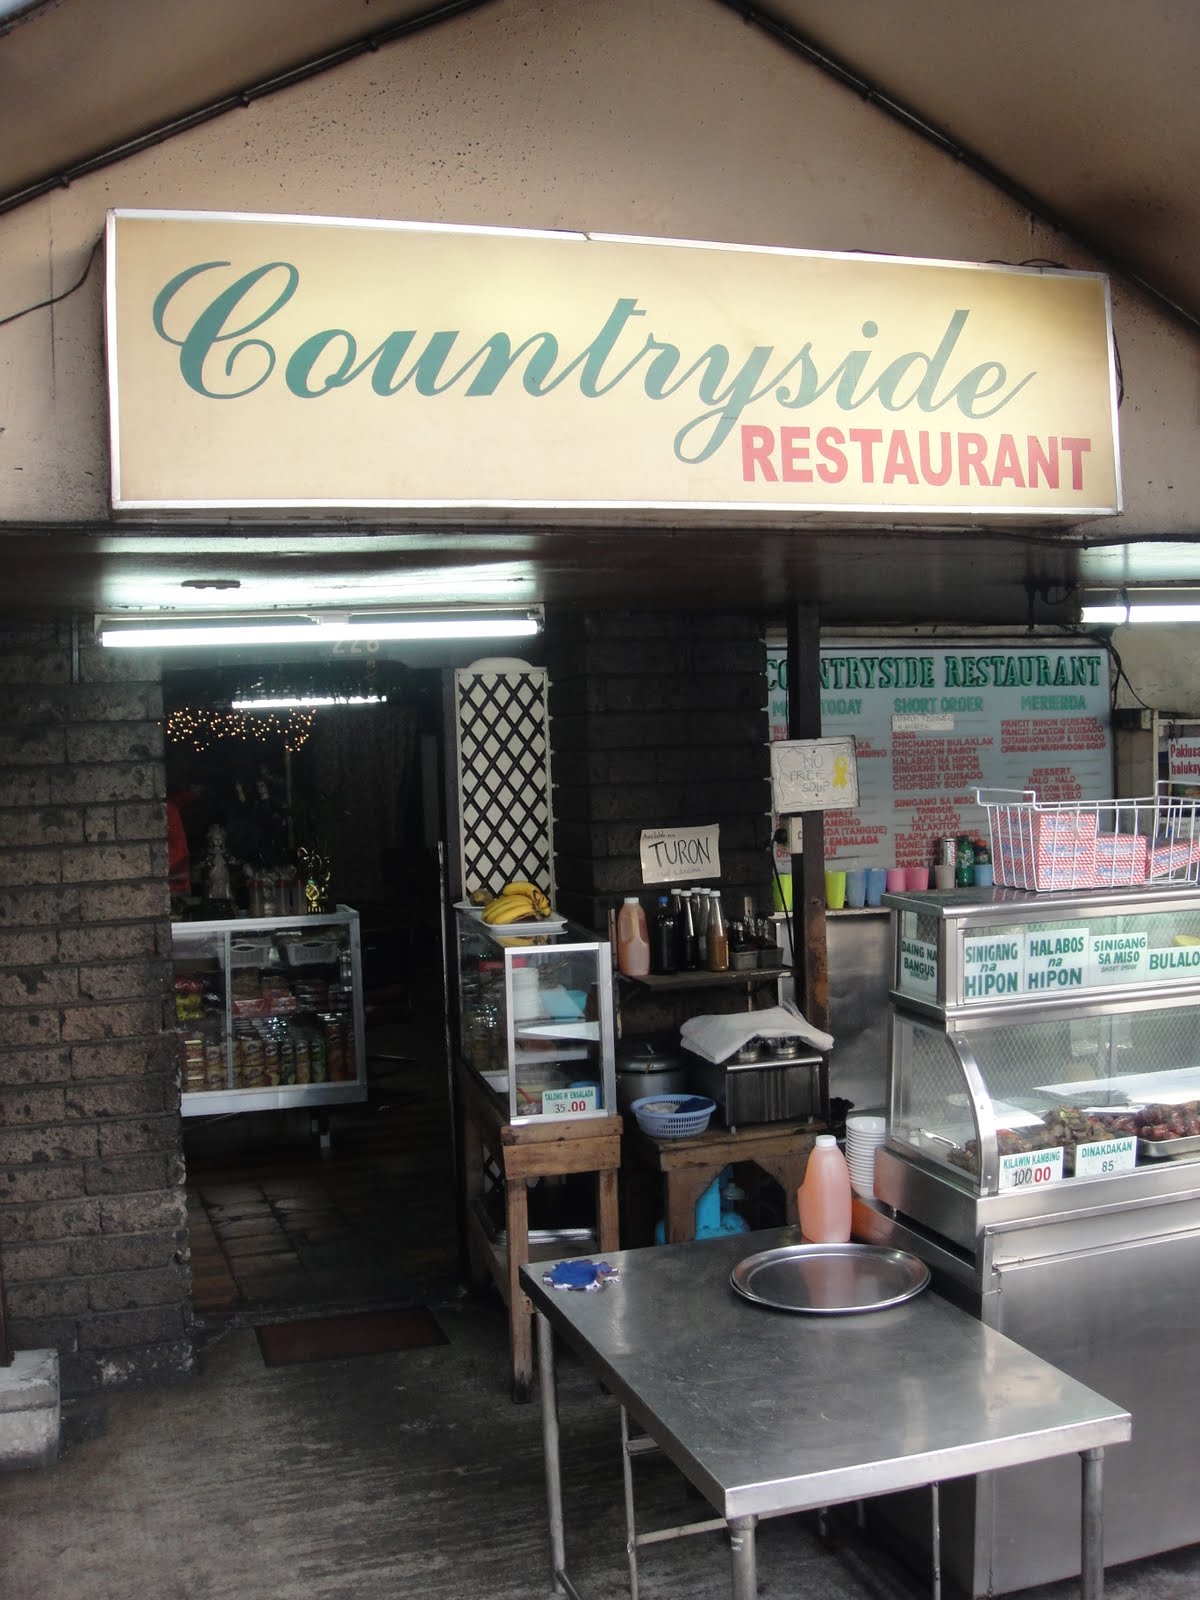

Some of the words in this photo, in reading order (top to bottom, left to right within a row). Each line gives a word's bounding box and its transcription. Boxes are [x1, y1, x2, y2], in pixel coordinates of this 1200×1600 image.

[153, 261, 1037, 464] Countryside
[742, 425, 1091, 490] RESTAURANT
[767, 657, 934, 691] CONTRYSIDE
[945, 655, 1101, 687] RESTAURANT
[821, 699, 862, 714] TODAY
[894, 697, 938, 713] SHORT
[941, 696, 984, 712] ORDER
[1021, 695, 1087, 712] MERIENDA
[1001, 720, 1030, 728] PANCIT
[1032, 719, 1057, 727] BIHON
[1060, 717, 1097, 726] GUISADO
[892, 731, 916, 740] SISIG
[1001, 728, 1029, 736] PANCIT
[1032, 727, 1065, 736] CANTON
[1068, 725, 1104, 734] GUISADO
[892, 739, 944, 749] CHICHARON
[1001, 745, 1028, 753] CREAM
[1030, 744, 1040, 752] OF
[1086, 742, 1106, 750] SOUP
[892, 748, 944, 757] CHICHARON
[947, 746, 977, 755] BABOY
[803, 753, 824, 769] NO
[893, 757, 935, 766] HALABOS
[938, 756, 950, 764] NA
[952, 755, 979, 764] HIPON
[893, 765, 936, 774] SINIGANG
[938, 764, 950, 772] NA
[952, 763, 980, 771] HIPON
[1032, 767, 1072, 777] DESSERT
[790, 770, 825, 781] FREE
[893, 773, 941, 782] CHOPSUEY
[944, 771, 983, 780] GUISADO
[1028, 776, 1048, 785] HALO
[1055, 776, 1076, 784] HALO
[802, 781, 831, 793] SOUP
[893, 781, 941, 790] CHOPSUEY
[944, 780, 968, 789] SOUP
[1044, 785, 1060, 793] CON
[1061, 783, 1081, 792] YELO
[1044, 793, 1060, 801] CON
[1062, 791, 1082, 800] YELO
[894, 799, 937, 807] SINIGANG
[940, 798, 951, 806] SA
[916, 806, 954, 814] TANIGUE
[911, 814, 960, 823] LAPU-LAPU
[911, 822, 960, 832] TALAKITOK
[829, 836, 879, 846] ENSALADA
[648, 837, 711, 867] TURON
[895, 850, 923, 859] DAING
[1030, 936, 1084, 957] HALABOS
[1094, 937, 1146, 952] SINIGANG
[901, 941, 925, 958] DAING
[927, 948, 938, 961] NA
[965, 943, 1018, 964] SINIGANG
[1047, 957, 1063, 968] na
[1098, 953, 1111, 965] SA
[1113, 951, 1140, 964] MISO
[1149, 950, 1200, 970] BULALO
[904, 957, 935, 977] BANGUS
[980, 962, 997, 972] na
[1100, 965, 1119, 973] SHORT
[1028, 967, 1082, 989] HIPON
[965, 972, 1018, 996] HIPON
[545, 1093, 563, 1101] TALONG
[570, 1089, 593, 1099] ENSALADA
[1081, 1140, 1133, 1158] DINAKDAKAN
[1003, 1156, 1031, 1169] KILAWIN
[1031, 1151, 1060, 1165] KAMBING
[1101, 1160, 1114, 1173] 85
